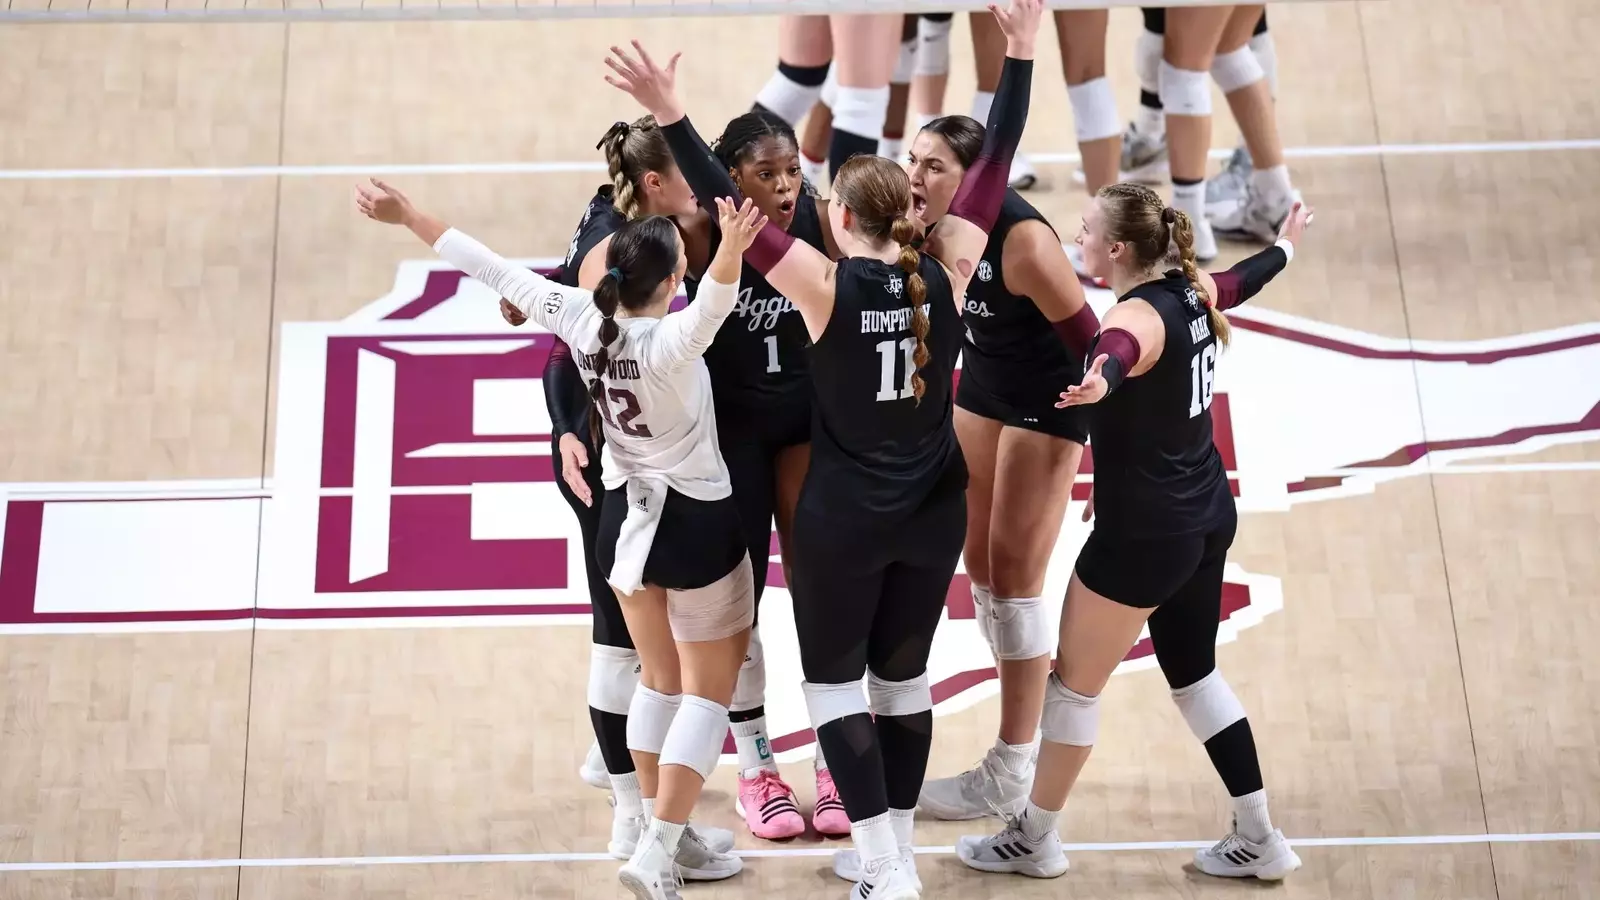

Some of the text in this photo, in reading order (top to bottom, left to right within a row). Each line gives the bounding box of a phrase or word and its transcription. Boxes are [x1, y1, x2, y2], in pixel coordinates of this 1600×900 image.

[733, 286, 798, 332] Aggi
[861, 303, 931, 333] HUMPHRY
[963, 292, 995, 317] ies
[763, 335, 781, 373] 1
[876, 336, 918, 402] 11
[1189, 342, 1216, 419] 16
[589, 378, 653, 437] 12
